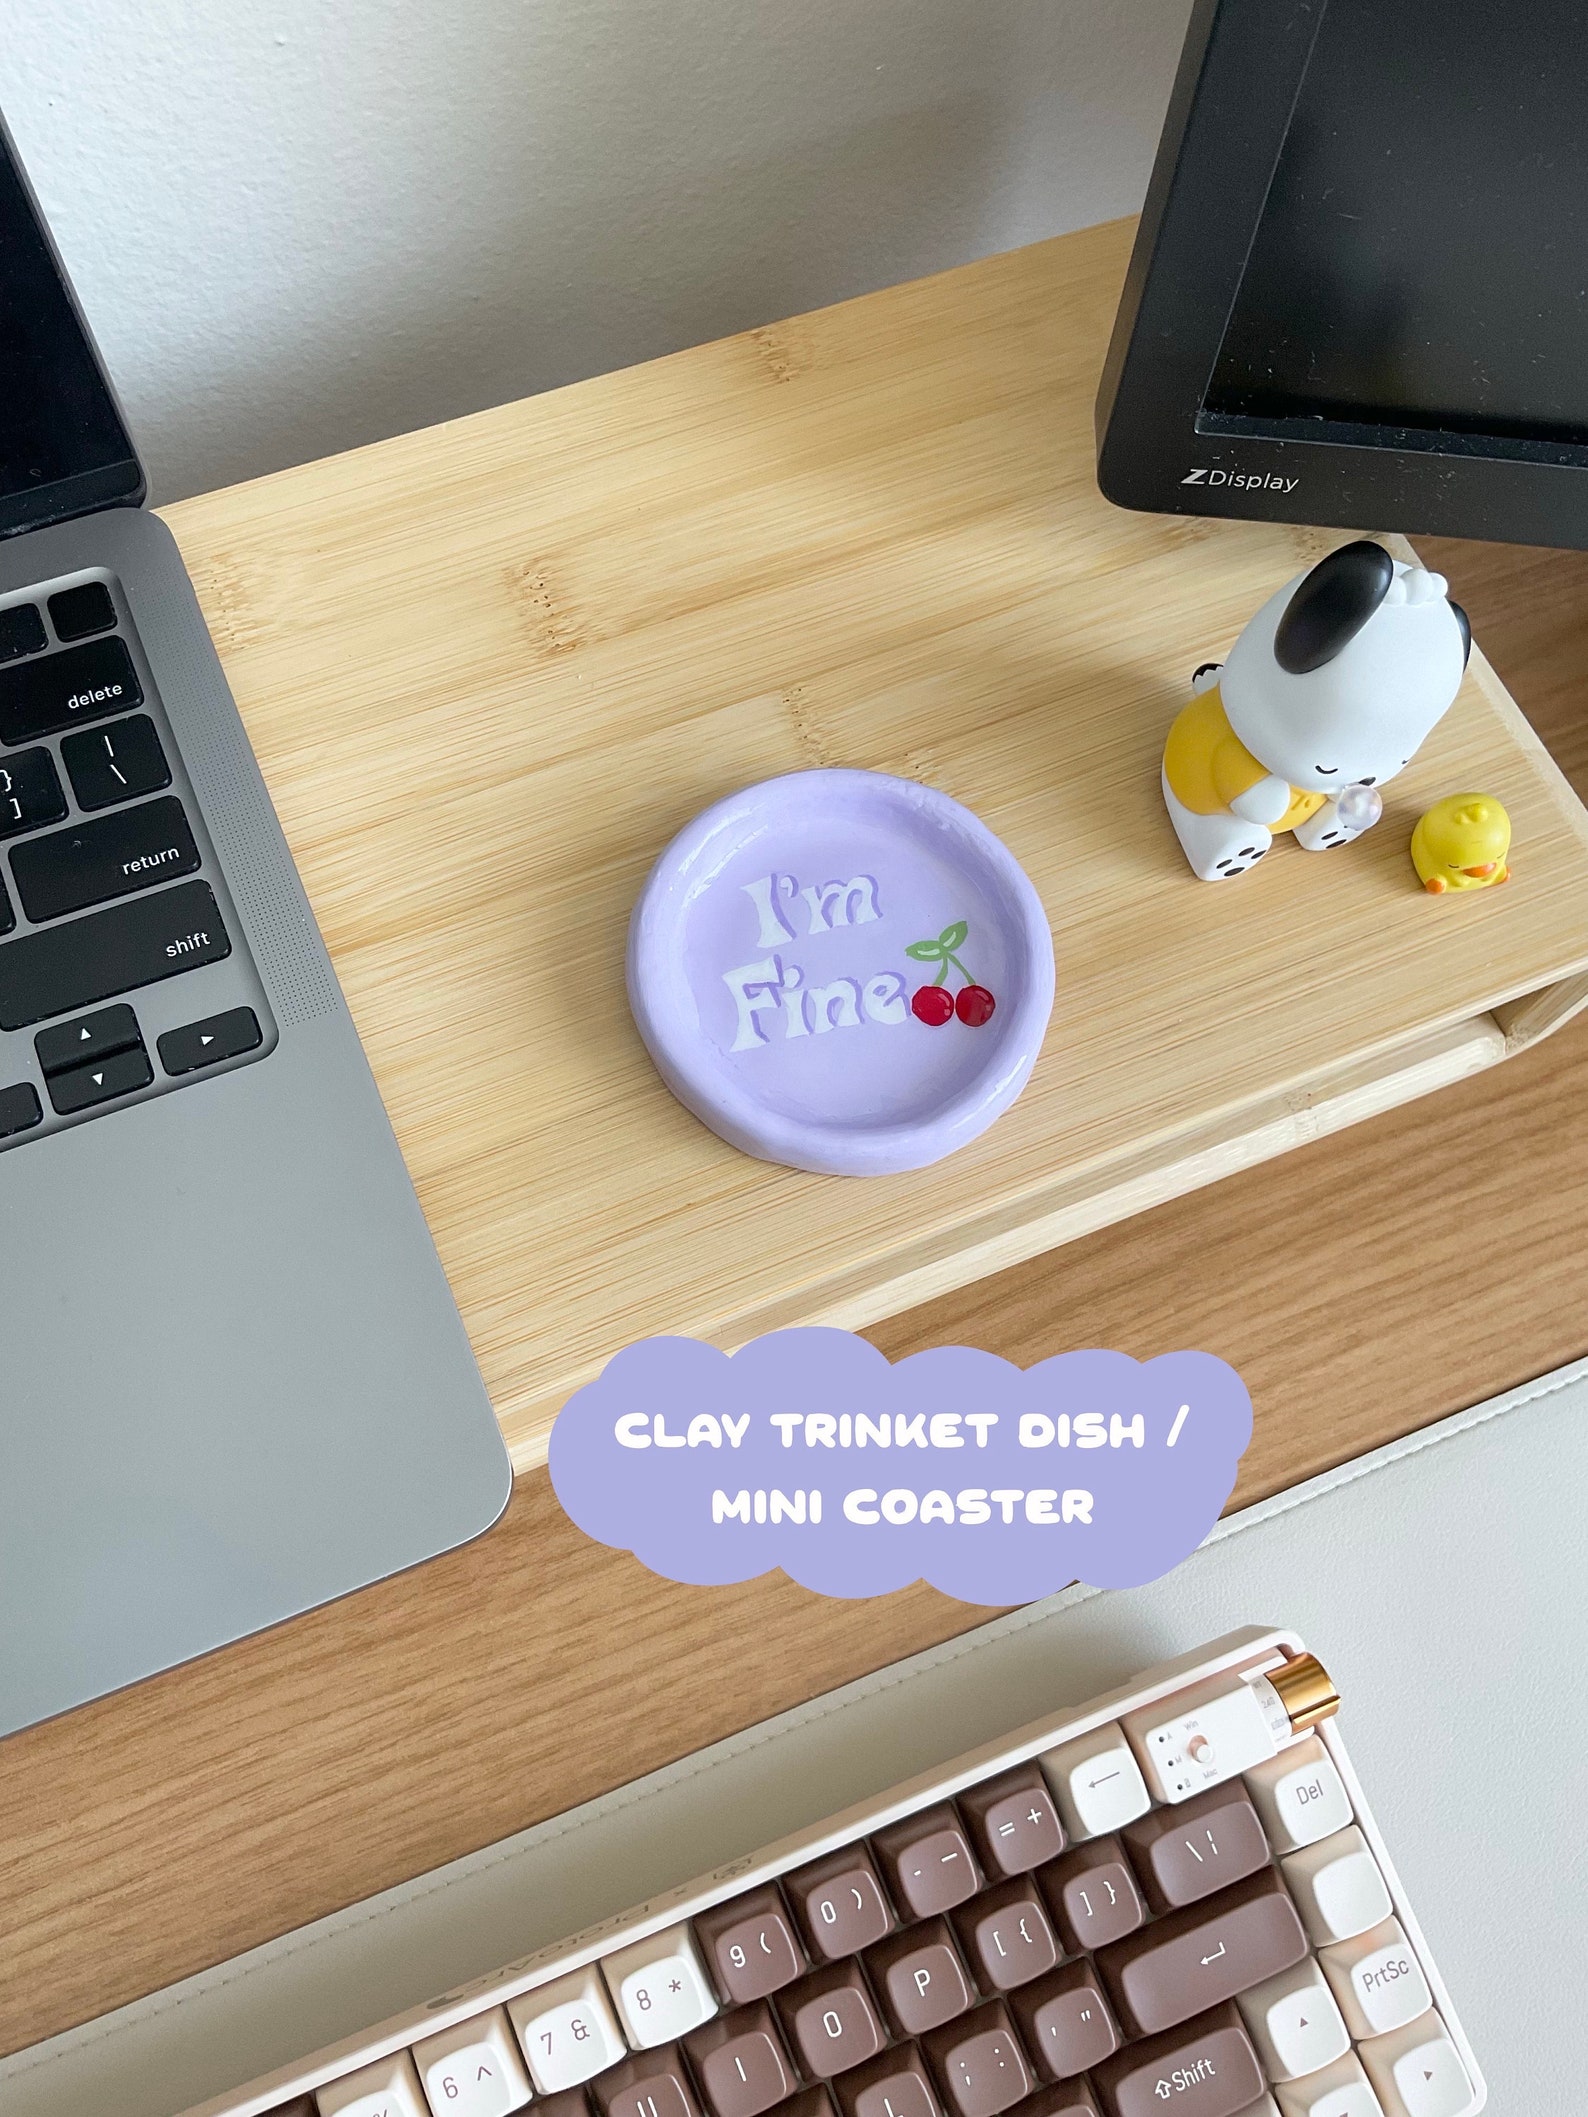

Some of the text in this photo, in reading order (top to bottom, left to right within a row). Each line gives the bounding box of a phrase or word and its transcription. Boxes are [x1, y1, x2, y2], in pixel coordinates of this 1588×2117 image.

[67, 684, 123, 709] delete
[110, 764, 127, 784] \
[9, 798, 22, 819] ]
[122, 847, 180, 875] return
[740, 873, 883, 948] I'm
[166, 932, 211, 957] shift
[722, 954, 911, 1053] Fine
[1184, 1719, 1199, 1731] Win
[1202, 1767, 1218, 1780] Mac
[1295, 1779, 1324, 1805] Del
[999, 1808, 1042, 1837] = +
[1185, 1841, 1204, 1862] \
[851, 1888, 862, 1910] )
[1080, 1880, 1117, 1916] ] }
[729, 1932, 771, 1968] 9 (
[993, 1918, 1033, 1957] [ {
[913, 1969, 931, 1997] P
[1362, 1958, 1410, 1993] PrtSc
[636, 1988, 652, 2011] 8
[1080, 2009, 1091, 2021] "
[540, 2019, 590, 2055] 7 &
[959, 2048, 1005, 2086] ; :
[1172, 2058, 1216, 2092] Shift
[443, 2076, 459, 2099] 6
